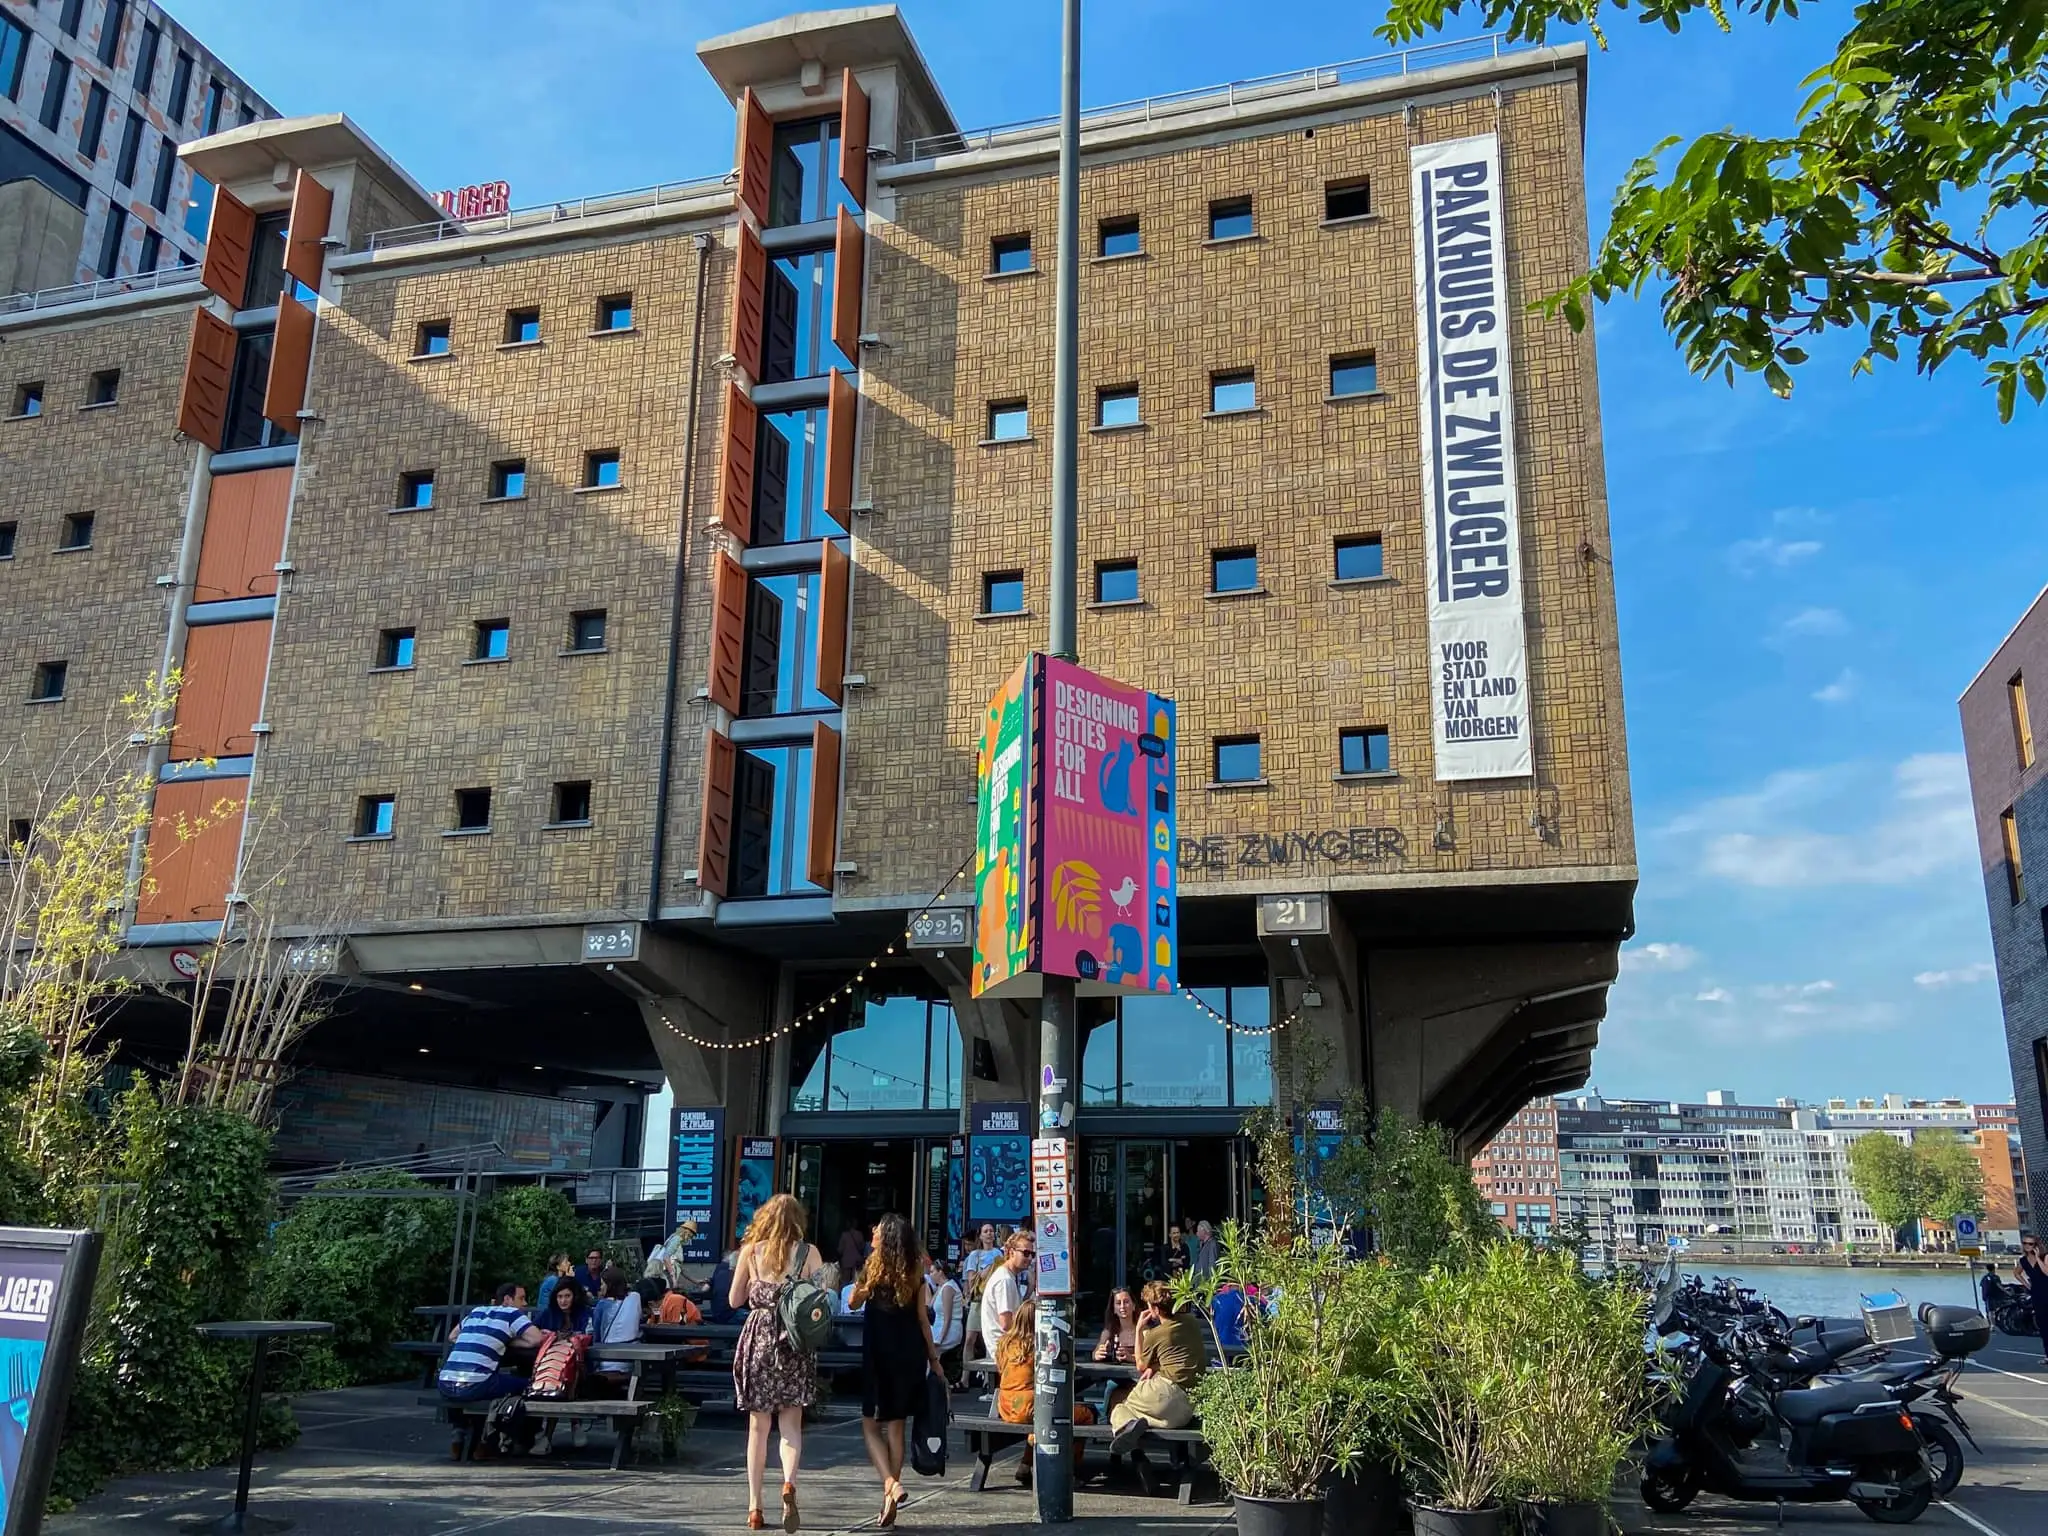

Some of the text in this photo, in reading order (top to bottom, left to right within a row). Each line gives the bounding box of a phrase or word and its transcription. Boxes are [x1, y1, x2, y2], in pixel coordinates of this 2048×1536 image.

[1435, 160, 1510, 602] PAKHUIS DE ZWIJGER
[1441, 640, 1489, 662] VOOR
[1442, 660, 1487, 681] STAD
[1444, 677, 1517, 700] EN LAND
[1055, 680, 1139, 734] DESIGNING
[1444, 699, 1479, 719] VAN
[1055, 711, 1107, 752] CITIES
[1445, 715, 1518, 740] MORGEN
[1055, 740, 1087, 775] FOR
[1054, 768, 1085, 804] ALL
[1176, 836, 1224, 870] DE
[1276, 898, 1307, 925] 21
[680, 1112, 706, 1120] PAKHUIS
[673, 1133, 714, 1206] EETCAFÉ
[0, 1276, 54, 1313] JGER
